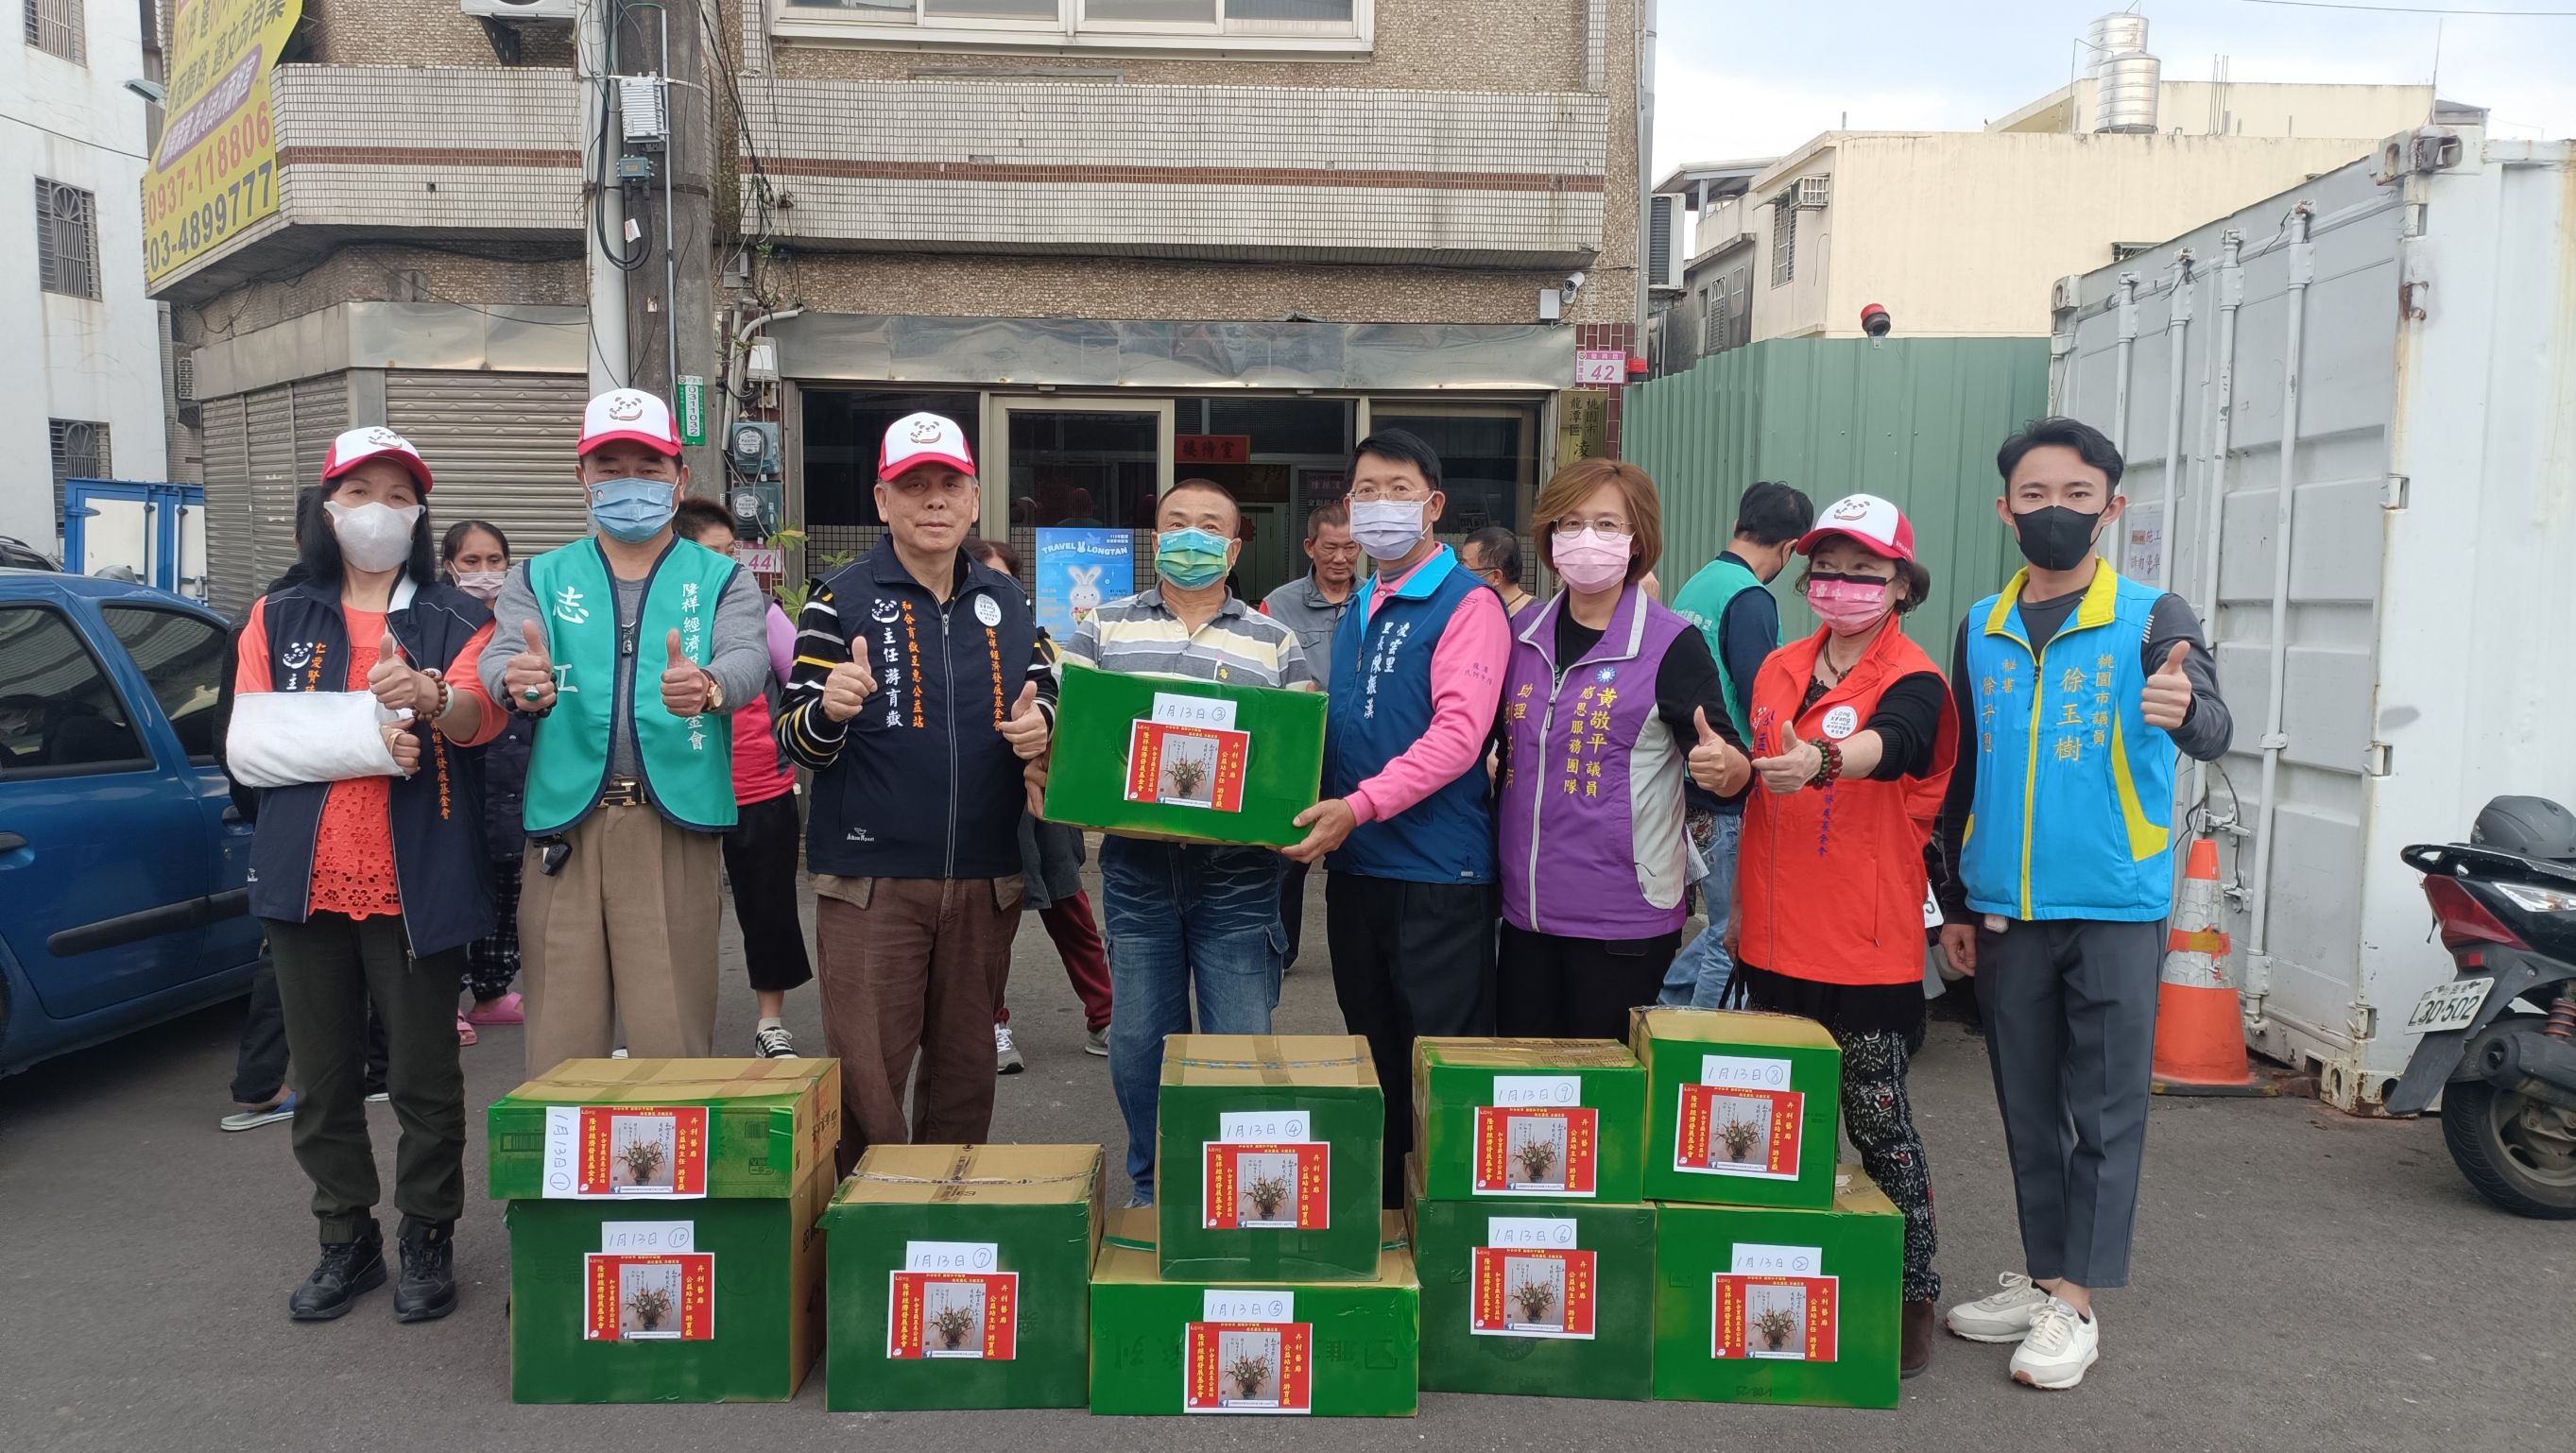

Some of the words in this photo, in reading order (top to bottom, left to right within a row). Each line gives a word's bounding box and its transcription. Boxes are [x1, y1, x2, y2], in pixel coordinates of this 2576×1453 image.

[147, 101, 270, 226] 0937-118806
[150, 159, 272, 272] 03-4899777
[1591, 365, 1614, 380] 42
[689, 387, 697, 435] 0311032
[1570, 398, 1582, 436] 龍潭區
[1586, 398, 1599, 436] 桃園市
[748, 555, 771, 570] 44
[1041, 543, 1076, 554] TRAVEL
[1087, 547, 1127, 556] LONGTAN
[1384, 622, 1410, 673] 凌雲里
[2001, 658, 2017, 694] 秘書
[1514, 683, 1534, 719] 助理
[2055, 667, 2087, 762] 徐玉樹
[2092, 653, 2115, 746] 桃園市議員
[2408, 996, 2480, 1026] L3D-502
